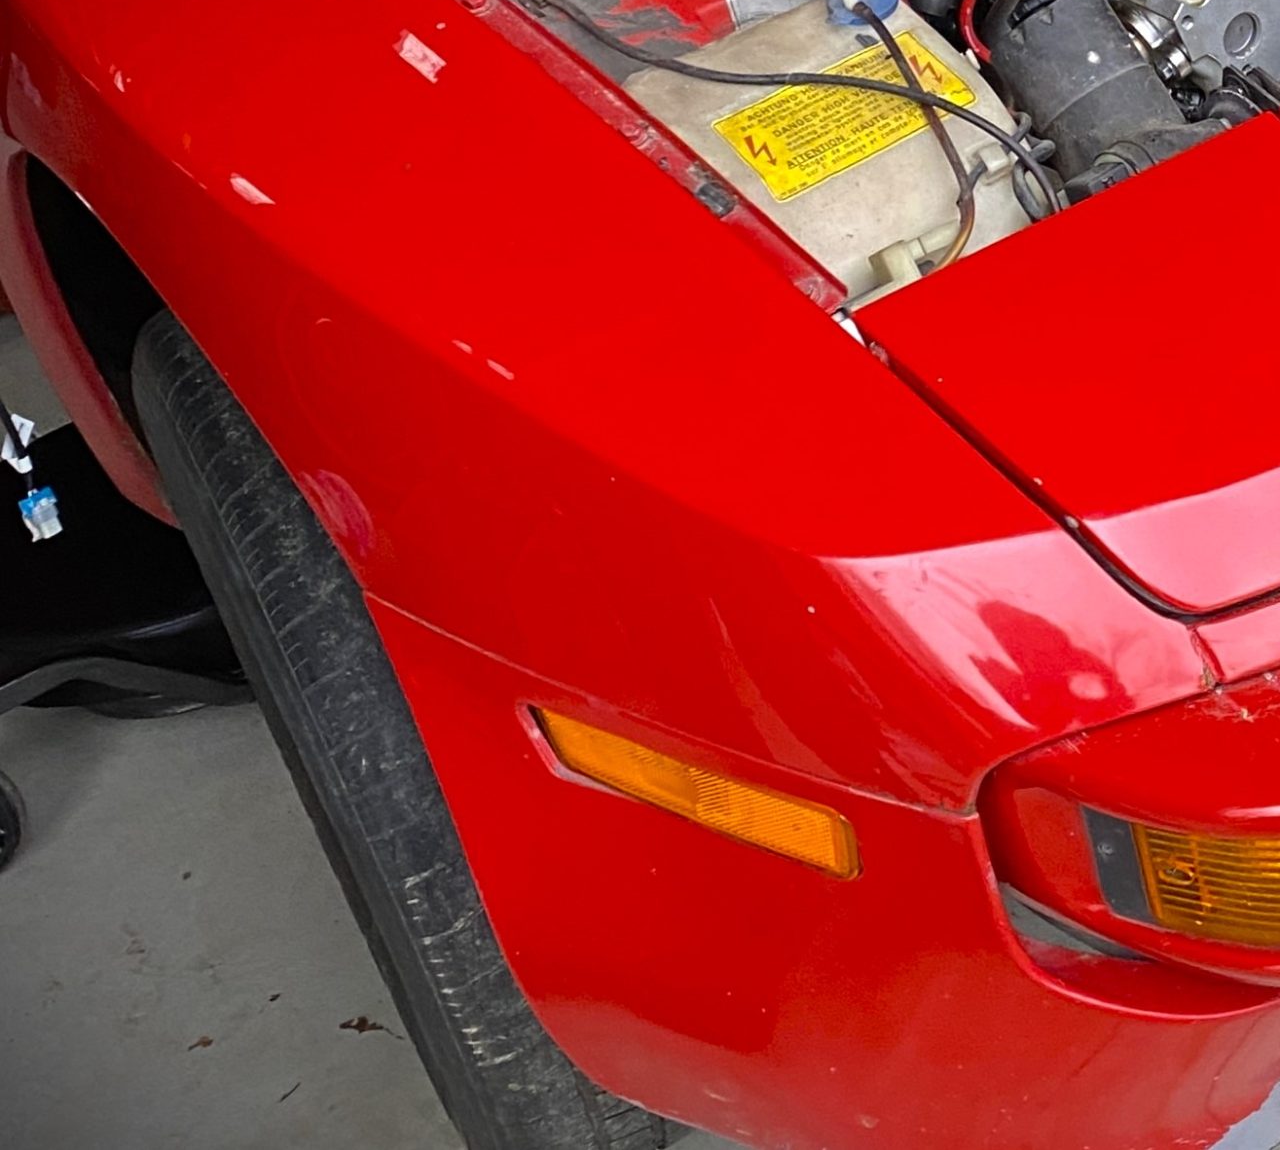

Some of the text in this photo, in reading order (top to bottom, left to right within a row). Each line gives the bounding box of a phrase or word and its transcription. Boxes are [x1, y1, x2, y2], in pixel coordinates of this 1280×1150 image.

[747, 93, 799, 122] ACHTUNG
[772, 112, 819, 137] DANGER
[821, 96, 849, 114] HIGH
[850, 113, 889, 135] HAUTE
